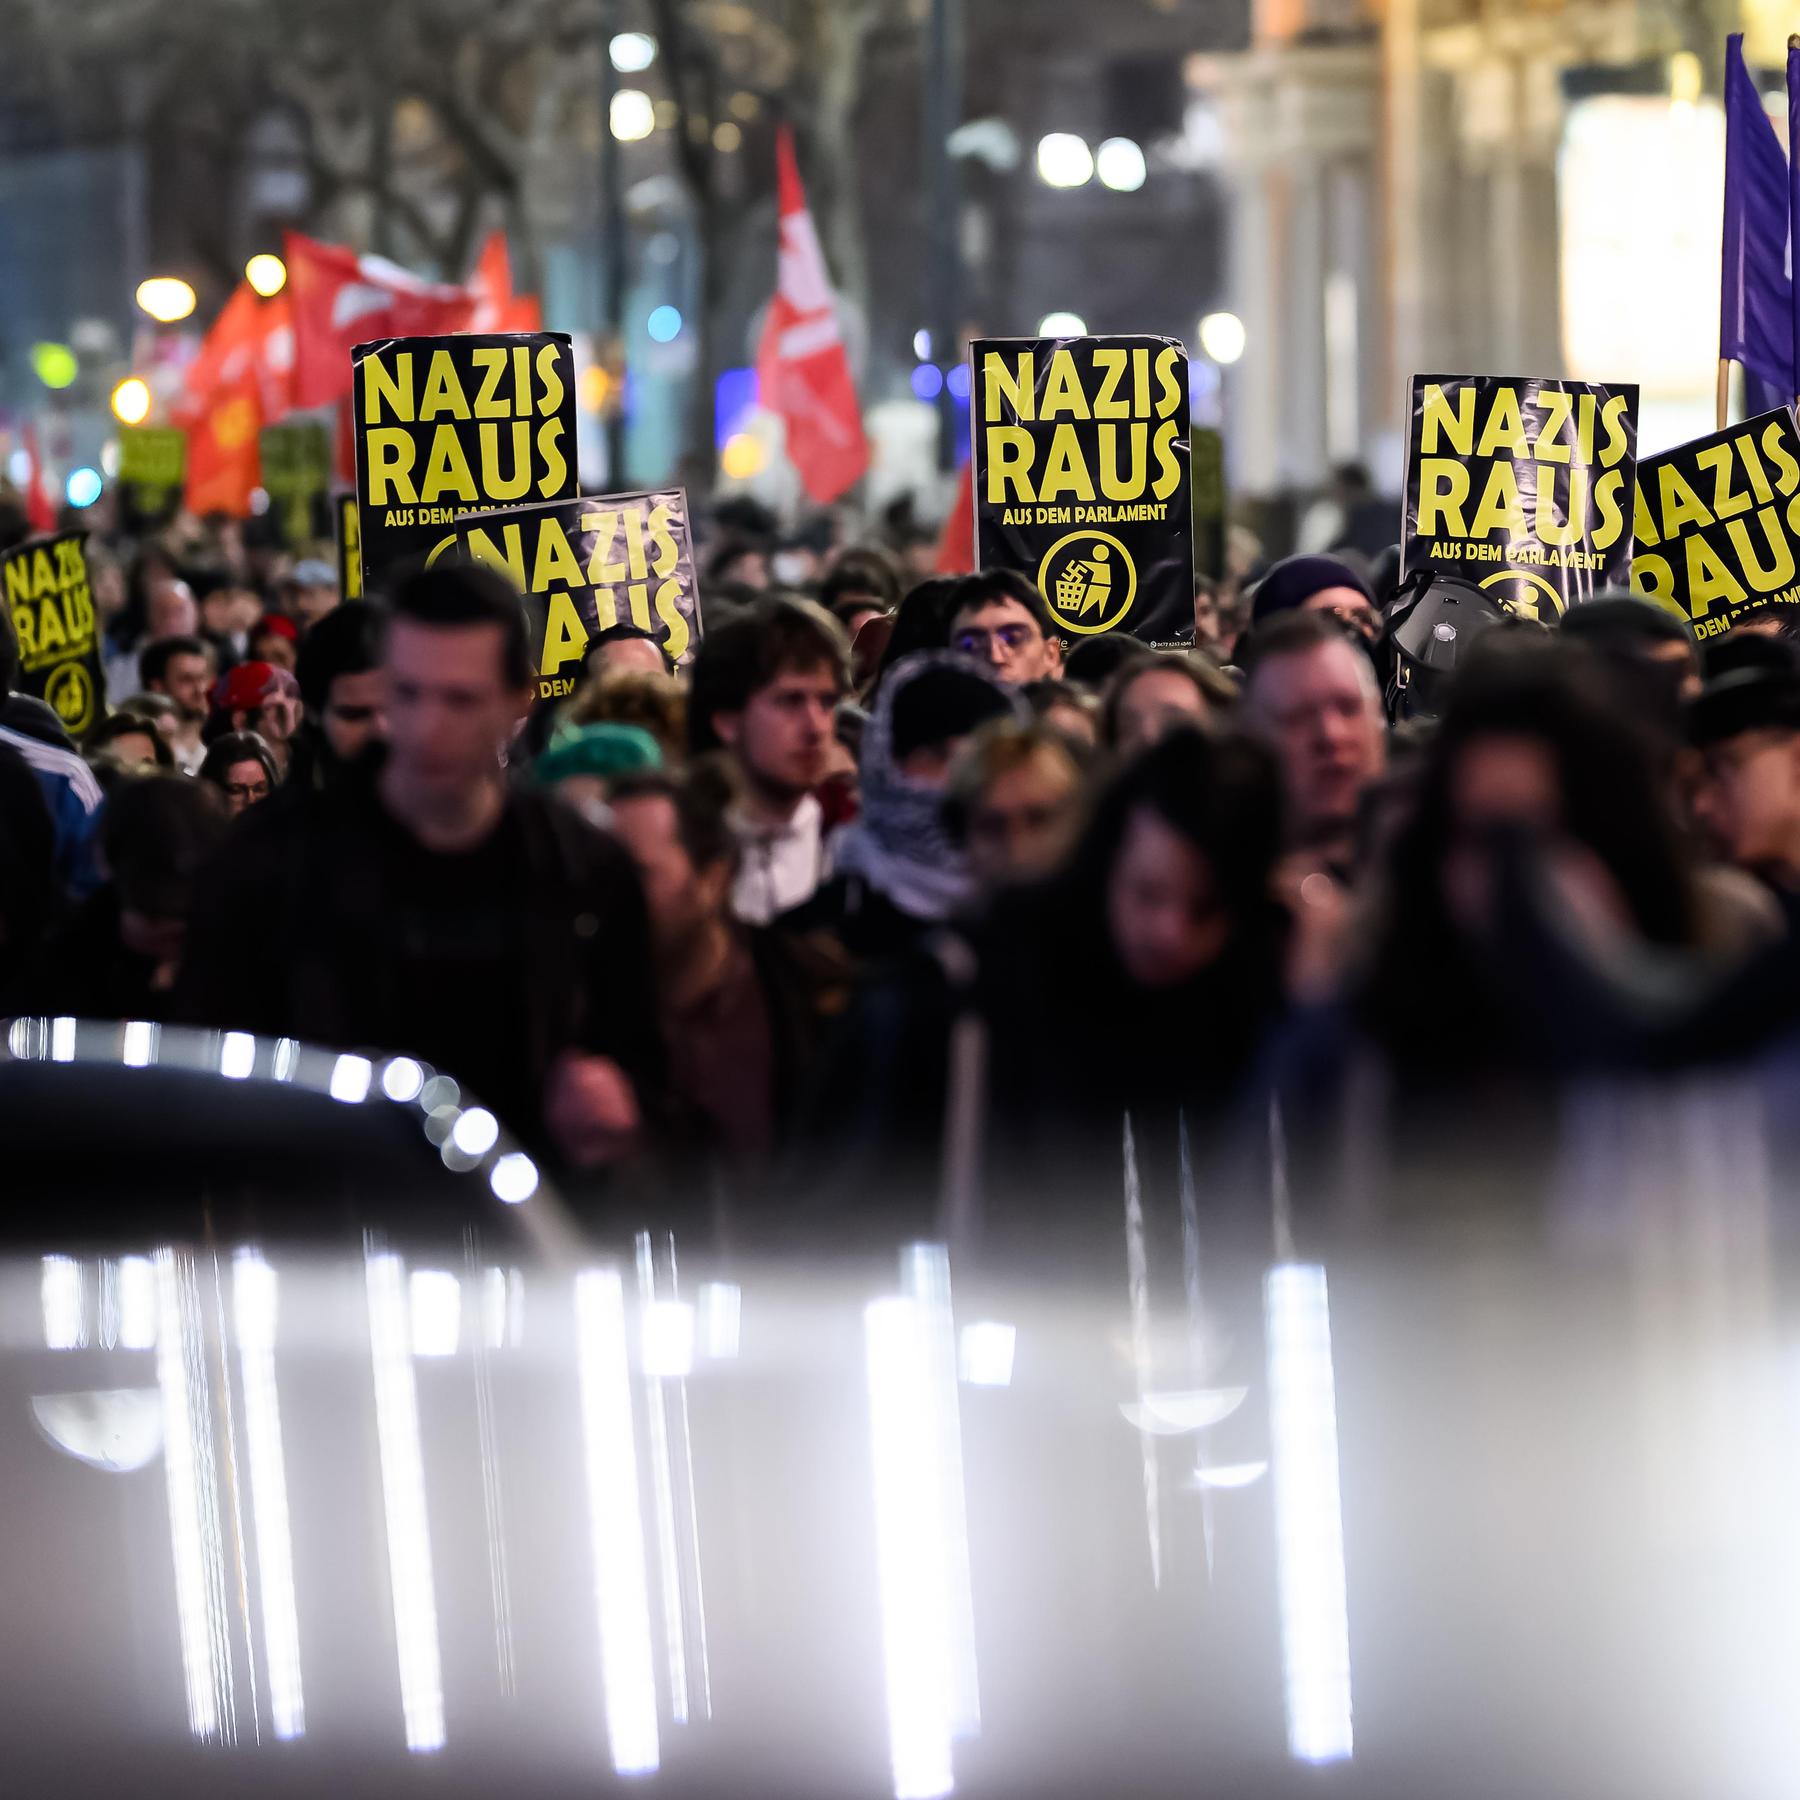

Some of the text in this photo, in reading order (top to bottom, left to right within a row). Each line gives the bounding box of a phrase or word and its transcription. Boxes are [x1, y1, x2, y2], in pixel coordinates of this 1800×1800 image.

[363, 343, 565, 424] NAZIS
[984, 346, 1182, 422] NAZIS
[366, 416, 567, 506] RAUS
[986, 419, 1181, 504] RAUS
[1420, 383, 1628, 468] NAZIS
[384, 509, 415, 527] AUS
[418, 507, 454, 525] DEM
[1002, 503, 1168, 526] AUS DEM PARLAMENT
[1416, 458, 1625, 551] RAUS
[467, 505, 679, 595] NAZIS
[1430, 541, 1607, 570] AUS DEM PARLAMENT
[532, 576, 690, 677] AUS
[1693, 614, 1731, 641] DEM
[539, 678, 576, 699] DEM
